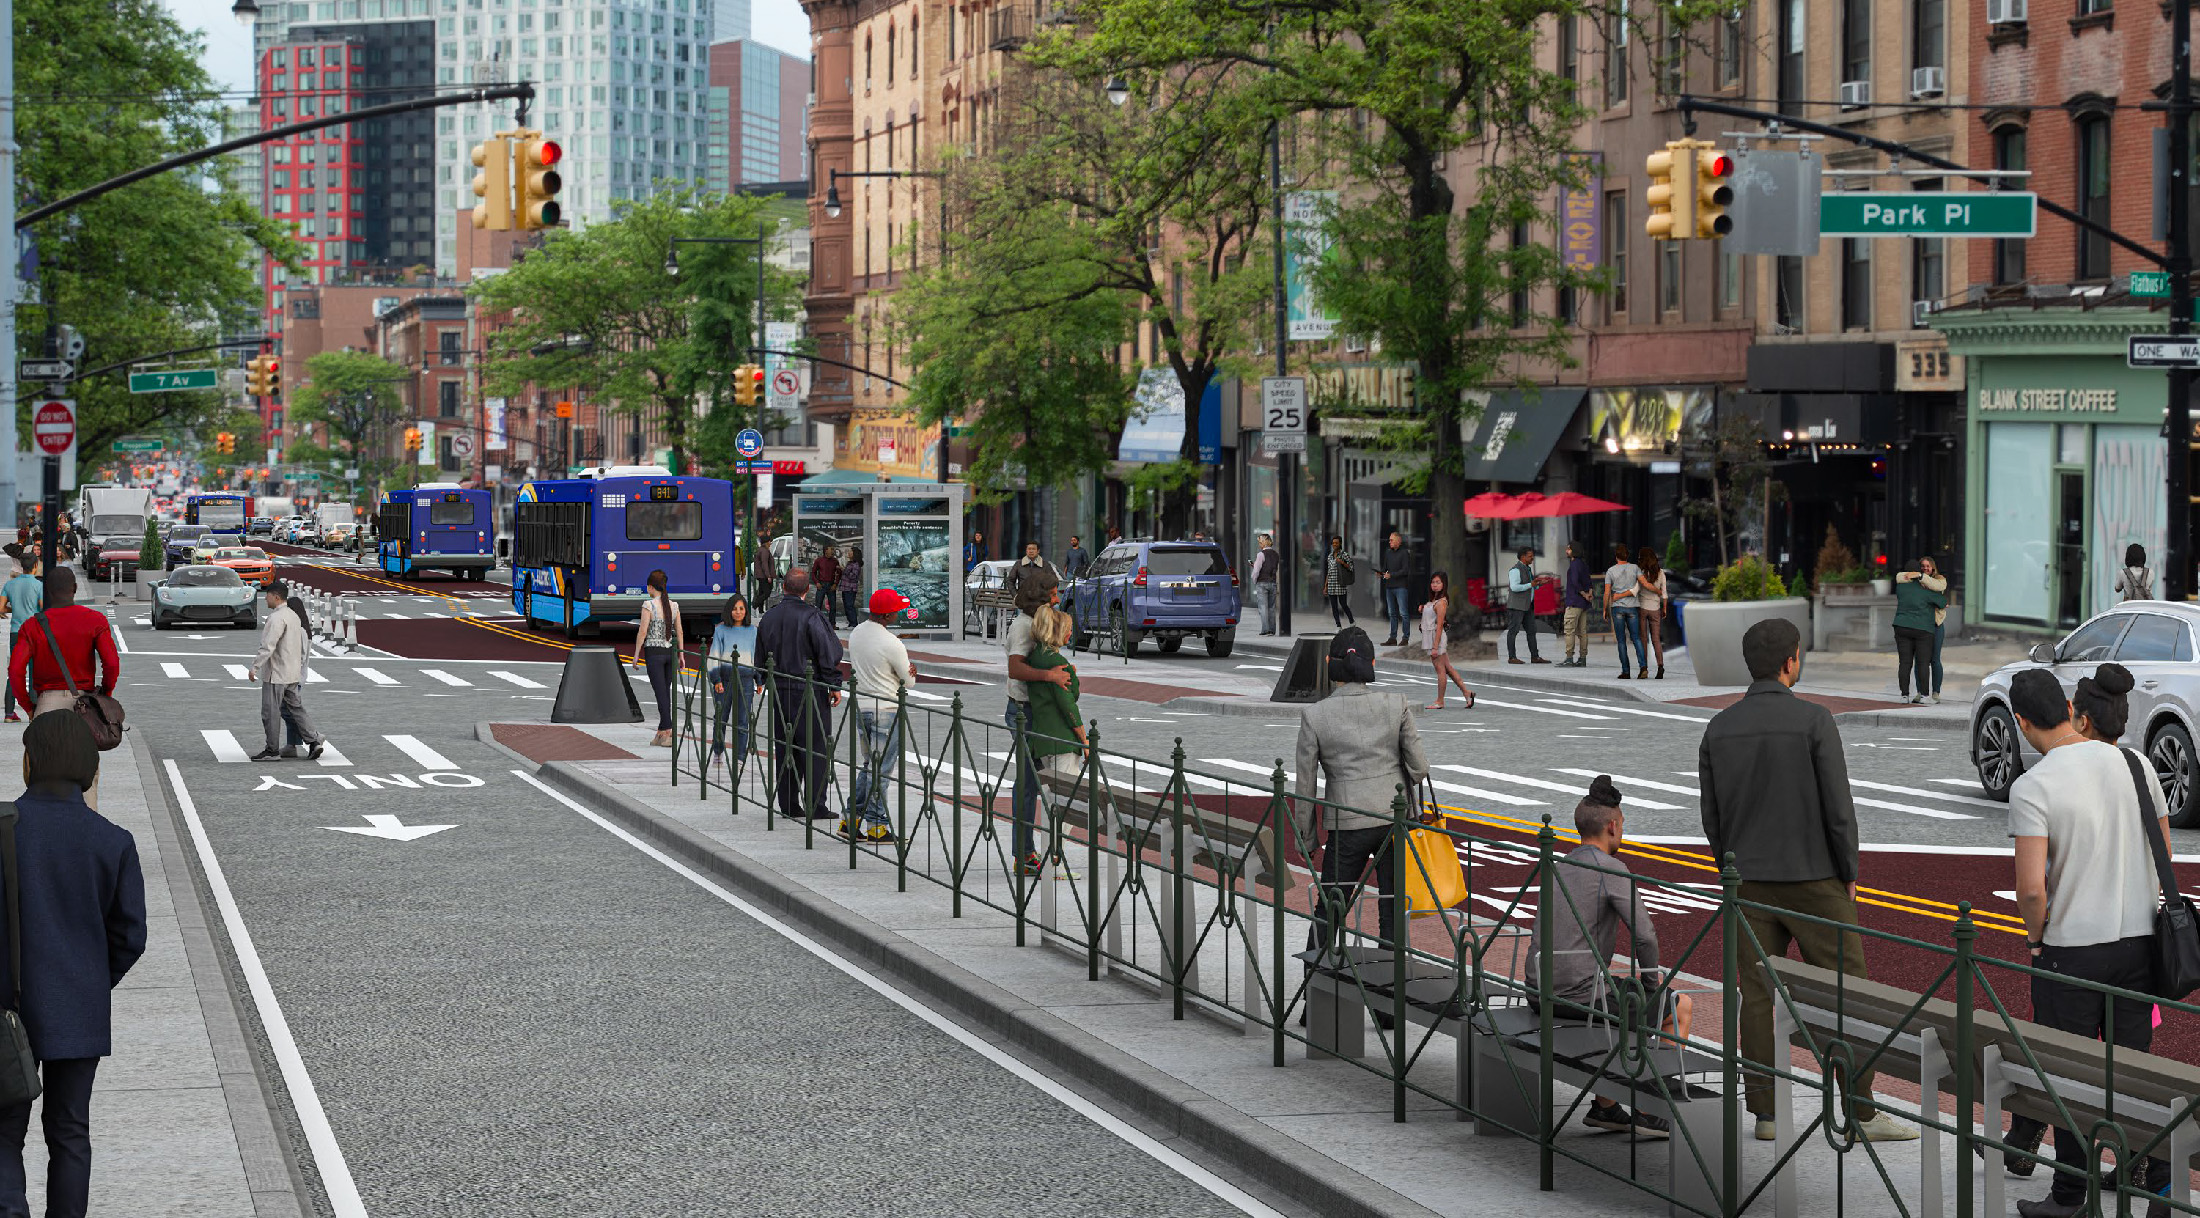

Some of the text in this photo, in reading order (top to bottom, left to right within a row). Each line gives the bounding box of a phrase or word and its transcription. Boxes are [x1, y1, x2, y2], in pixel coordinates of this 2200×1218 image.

[1863, 203, 1970, 226] Park Pl
[1296, 323, 1331, 332] AVENU
[2138, 345, 2200, 357] ONE WA
[25, 365, 67, 374] ONE WAY
[1912, 352, 1949, 378] 335
[156, 375, 190, 387] 7 Av
[1348, 367, 1414, 408] PALATE
[1980, 389, 2116, 412] BLANK STREET COFFEE
[41, 411, 67, 421] DO NOT
[1269, 409, 1300, 428] 25
[43, 436, 67, 446] ENTER
[656, 486, 671, 499] B41
[252, 772, 486, 791] ONLY
